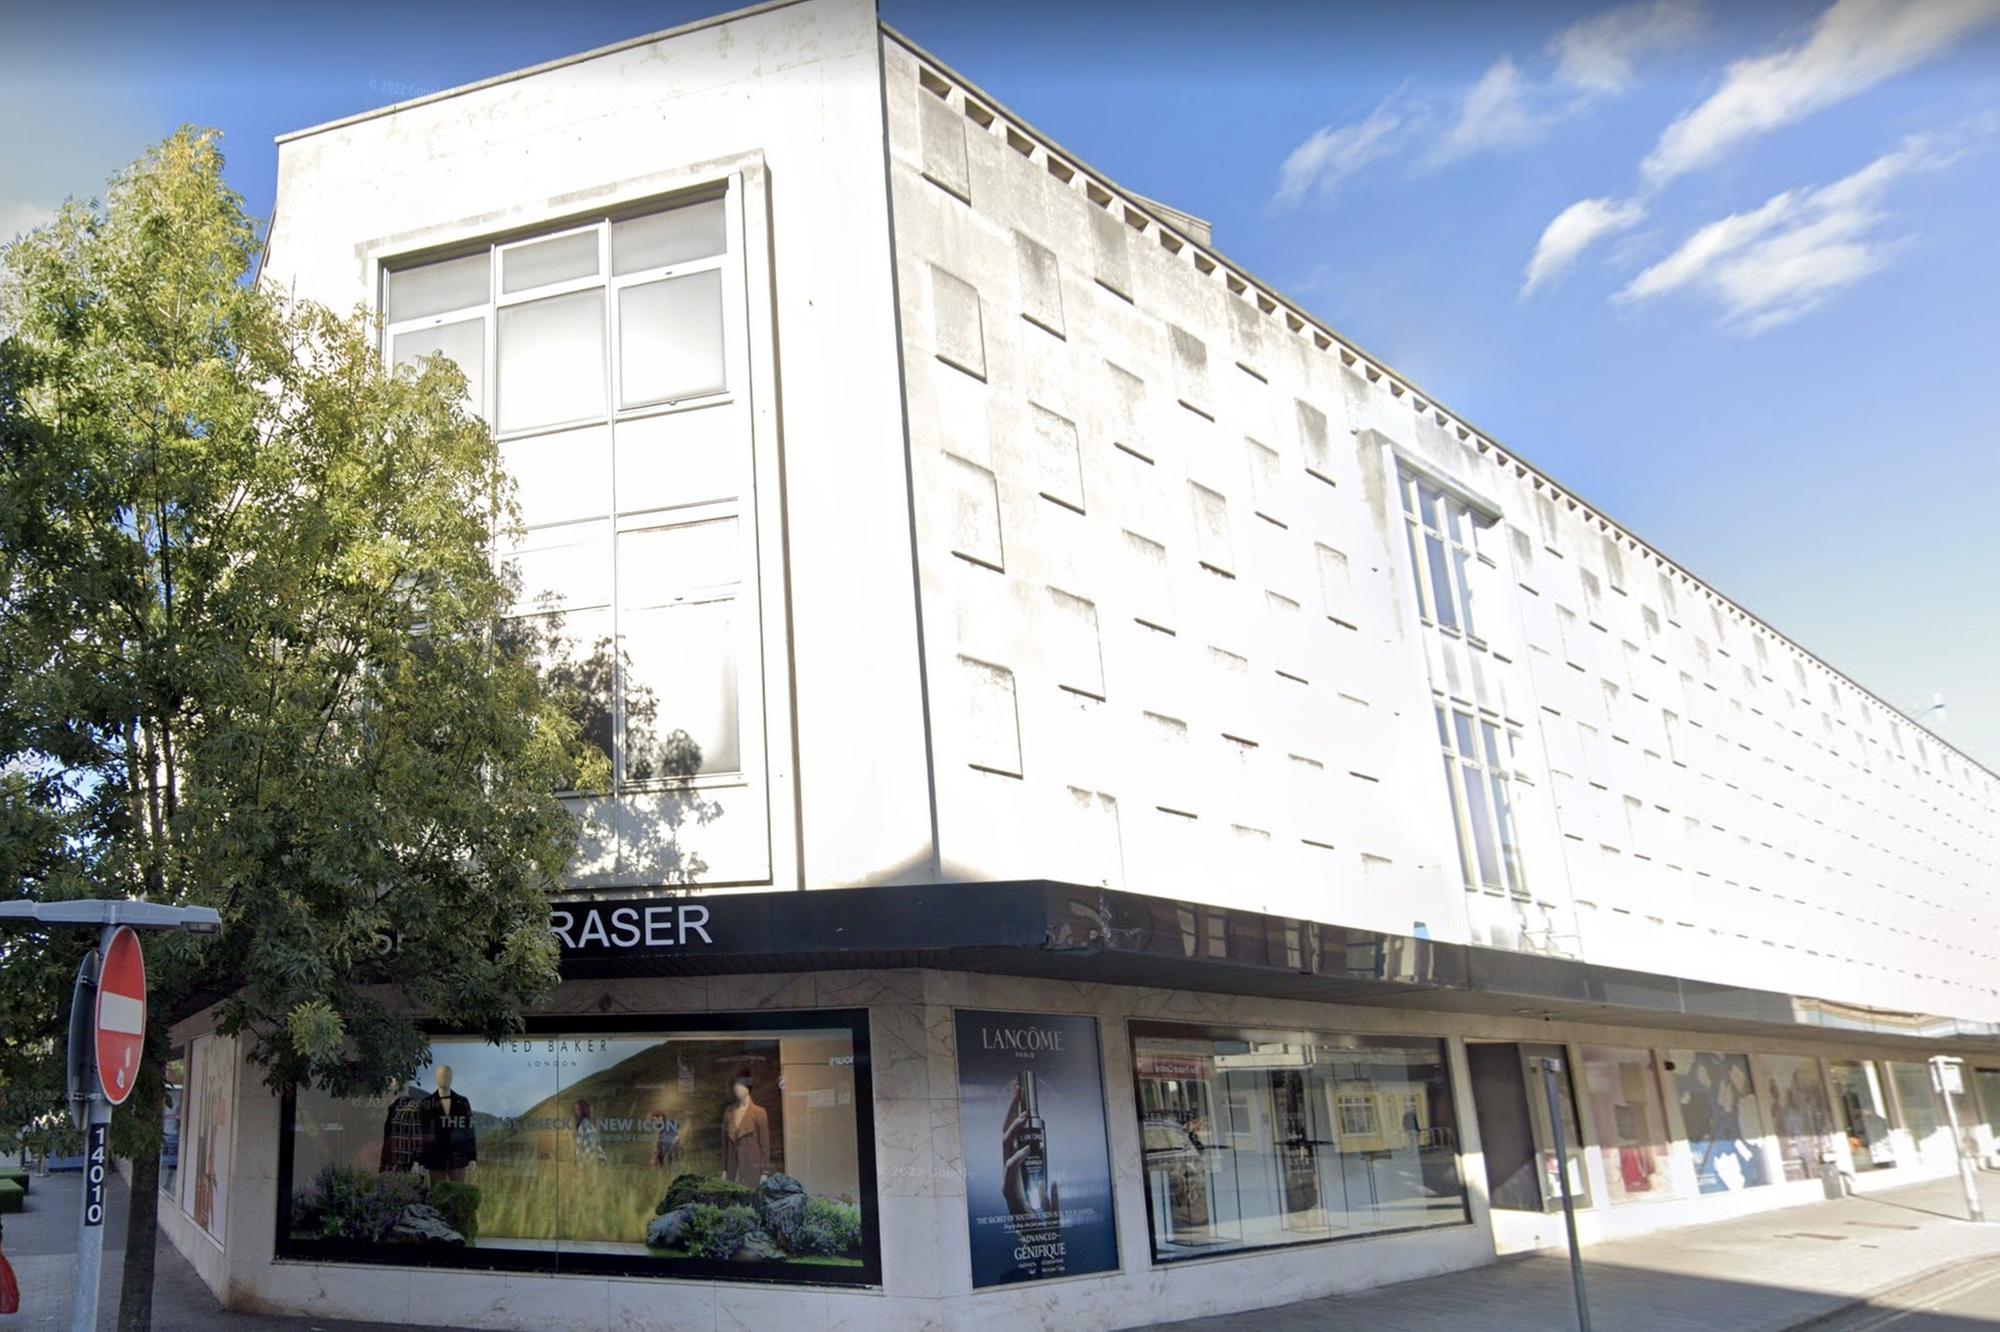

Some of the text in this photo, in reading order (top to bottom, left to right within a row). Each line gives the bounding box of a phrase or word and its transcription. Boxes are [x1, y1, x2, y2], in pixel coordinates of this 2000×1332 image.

[550, 905, 713, 949] RASER
[548, 1039, 608, 1052] BAKER
[982, 1026, 1064, 1051] LANCÔME
[528, 1060, 577, 1068] LONDON
[441, 1116, 466, 1129] THE
[599, 1118, 633, 1131] NEW
[638, 1119, 679, 1132] ICON
[87, 1127, 105, 1222] 14010
[1014, 1242, 1066, 1261] GÉNIFIQUE
